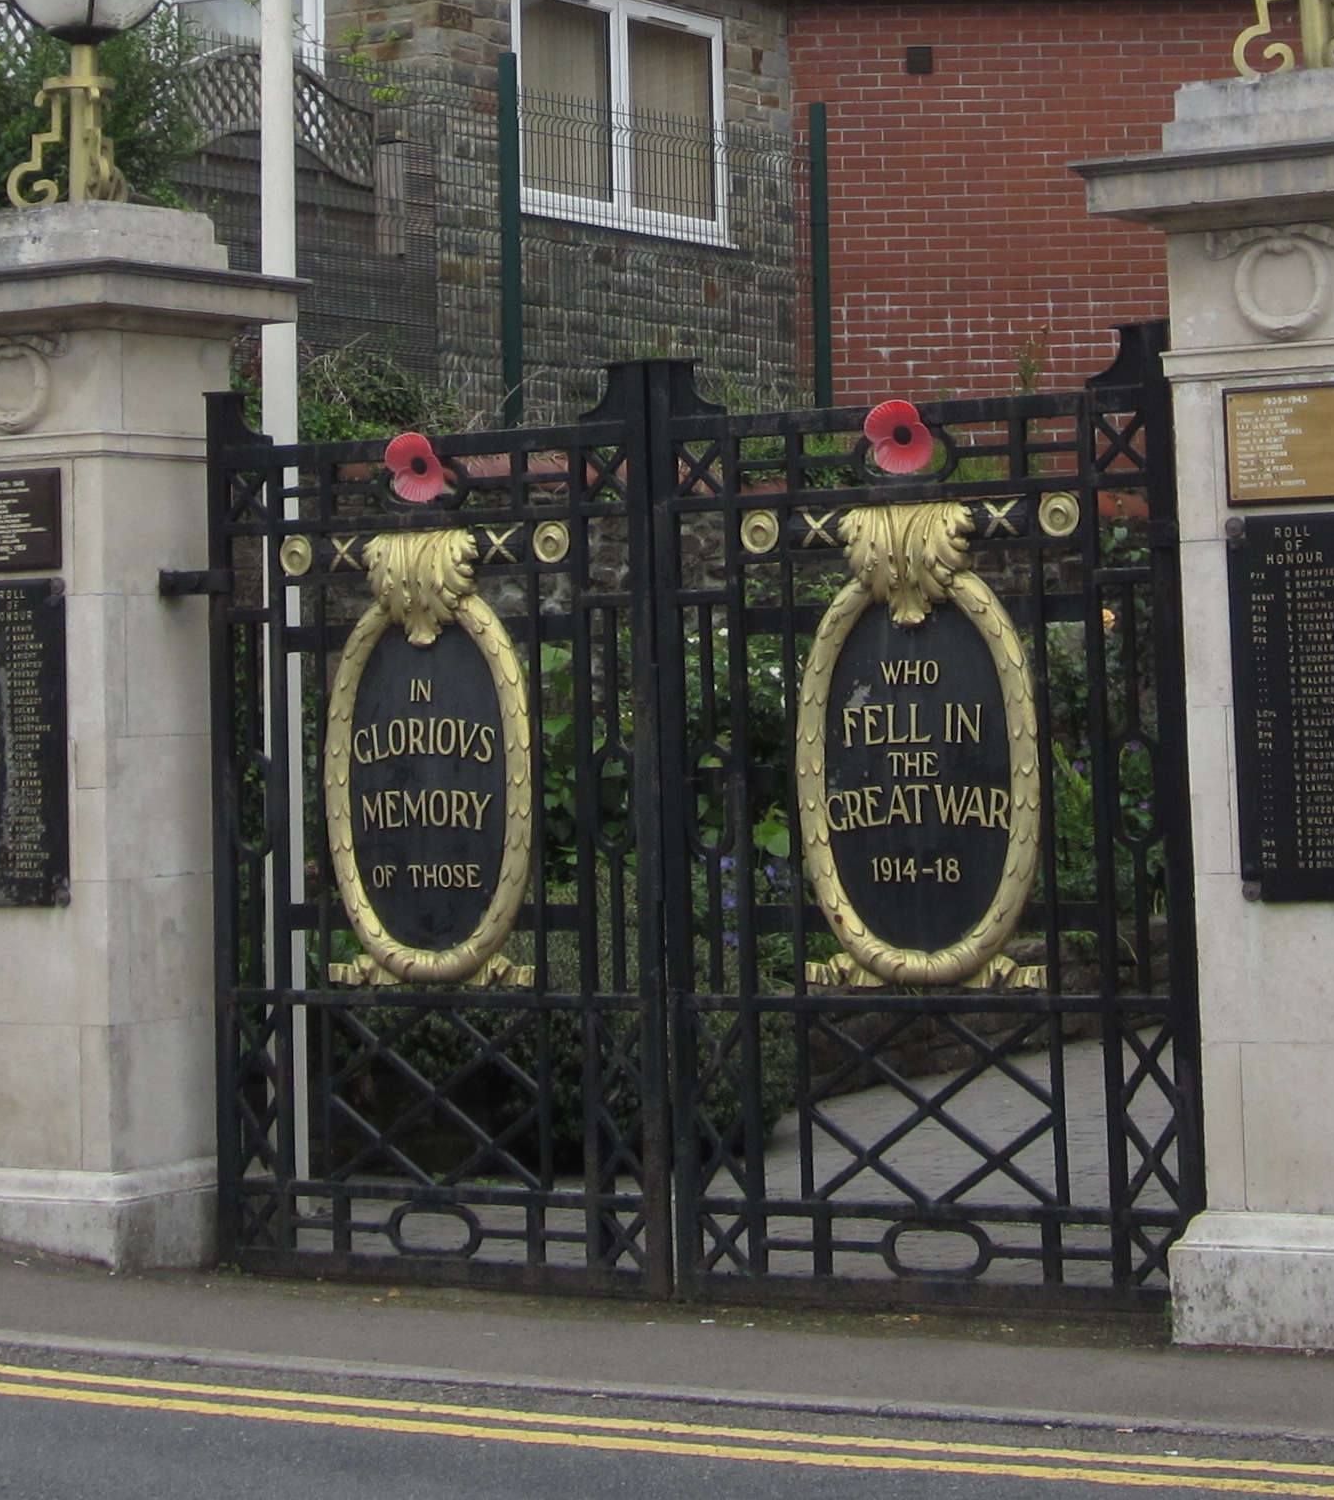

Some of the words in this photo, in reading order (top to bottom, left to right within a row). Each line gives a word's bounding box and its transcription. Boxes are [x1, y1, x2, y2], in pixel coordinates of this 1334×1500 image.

[1274, 526, 1310, 538] ROLL
[1285, 540, 1303, 551] OF
[1267, 552, 1323, 565] HONOUR
[0, 590, 26, 600] ROLL
[7, 601, 19, 610] OF
[1298, 612, 1334, 621] THOMAS
[881, 660, 939, 684] WHO
[409, 679, 431, 702] IN
[843, 703, 932, 747] FELL
[944, 703, 981, 743] IN
[887, 752, 939, 777] THE
[362, 789, 492, 831] MEMORY
[827, 785, 930, 832] GREAT
[934, 784, 1009, 829] WAR
[373, 865, 397, 888] OF
[407, 864, 482, 888] THOSE
